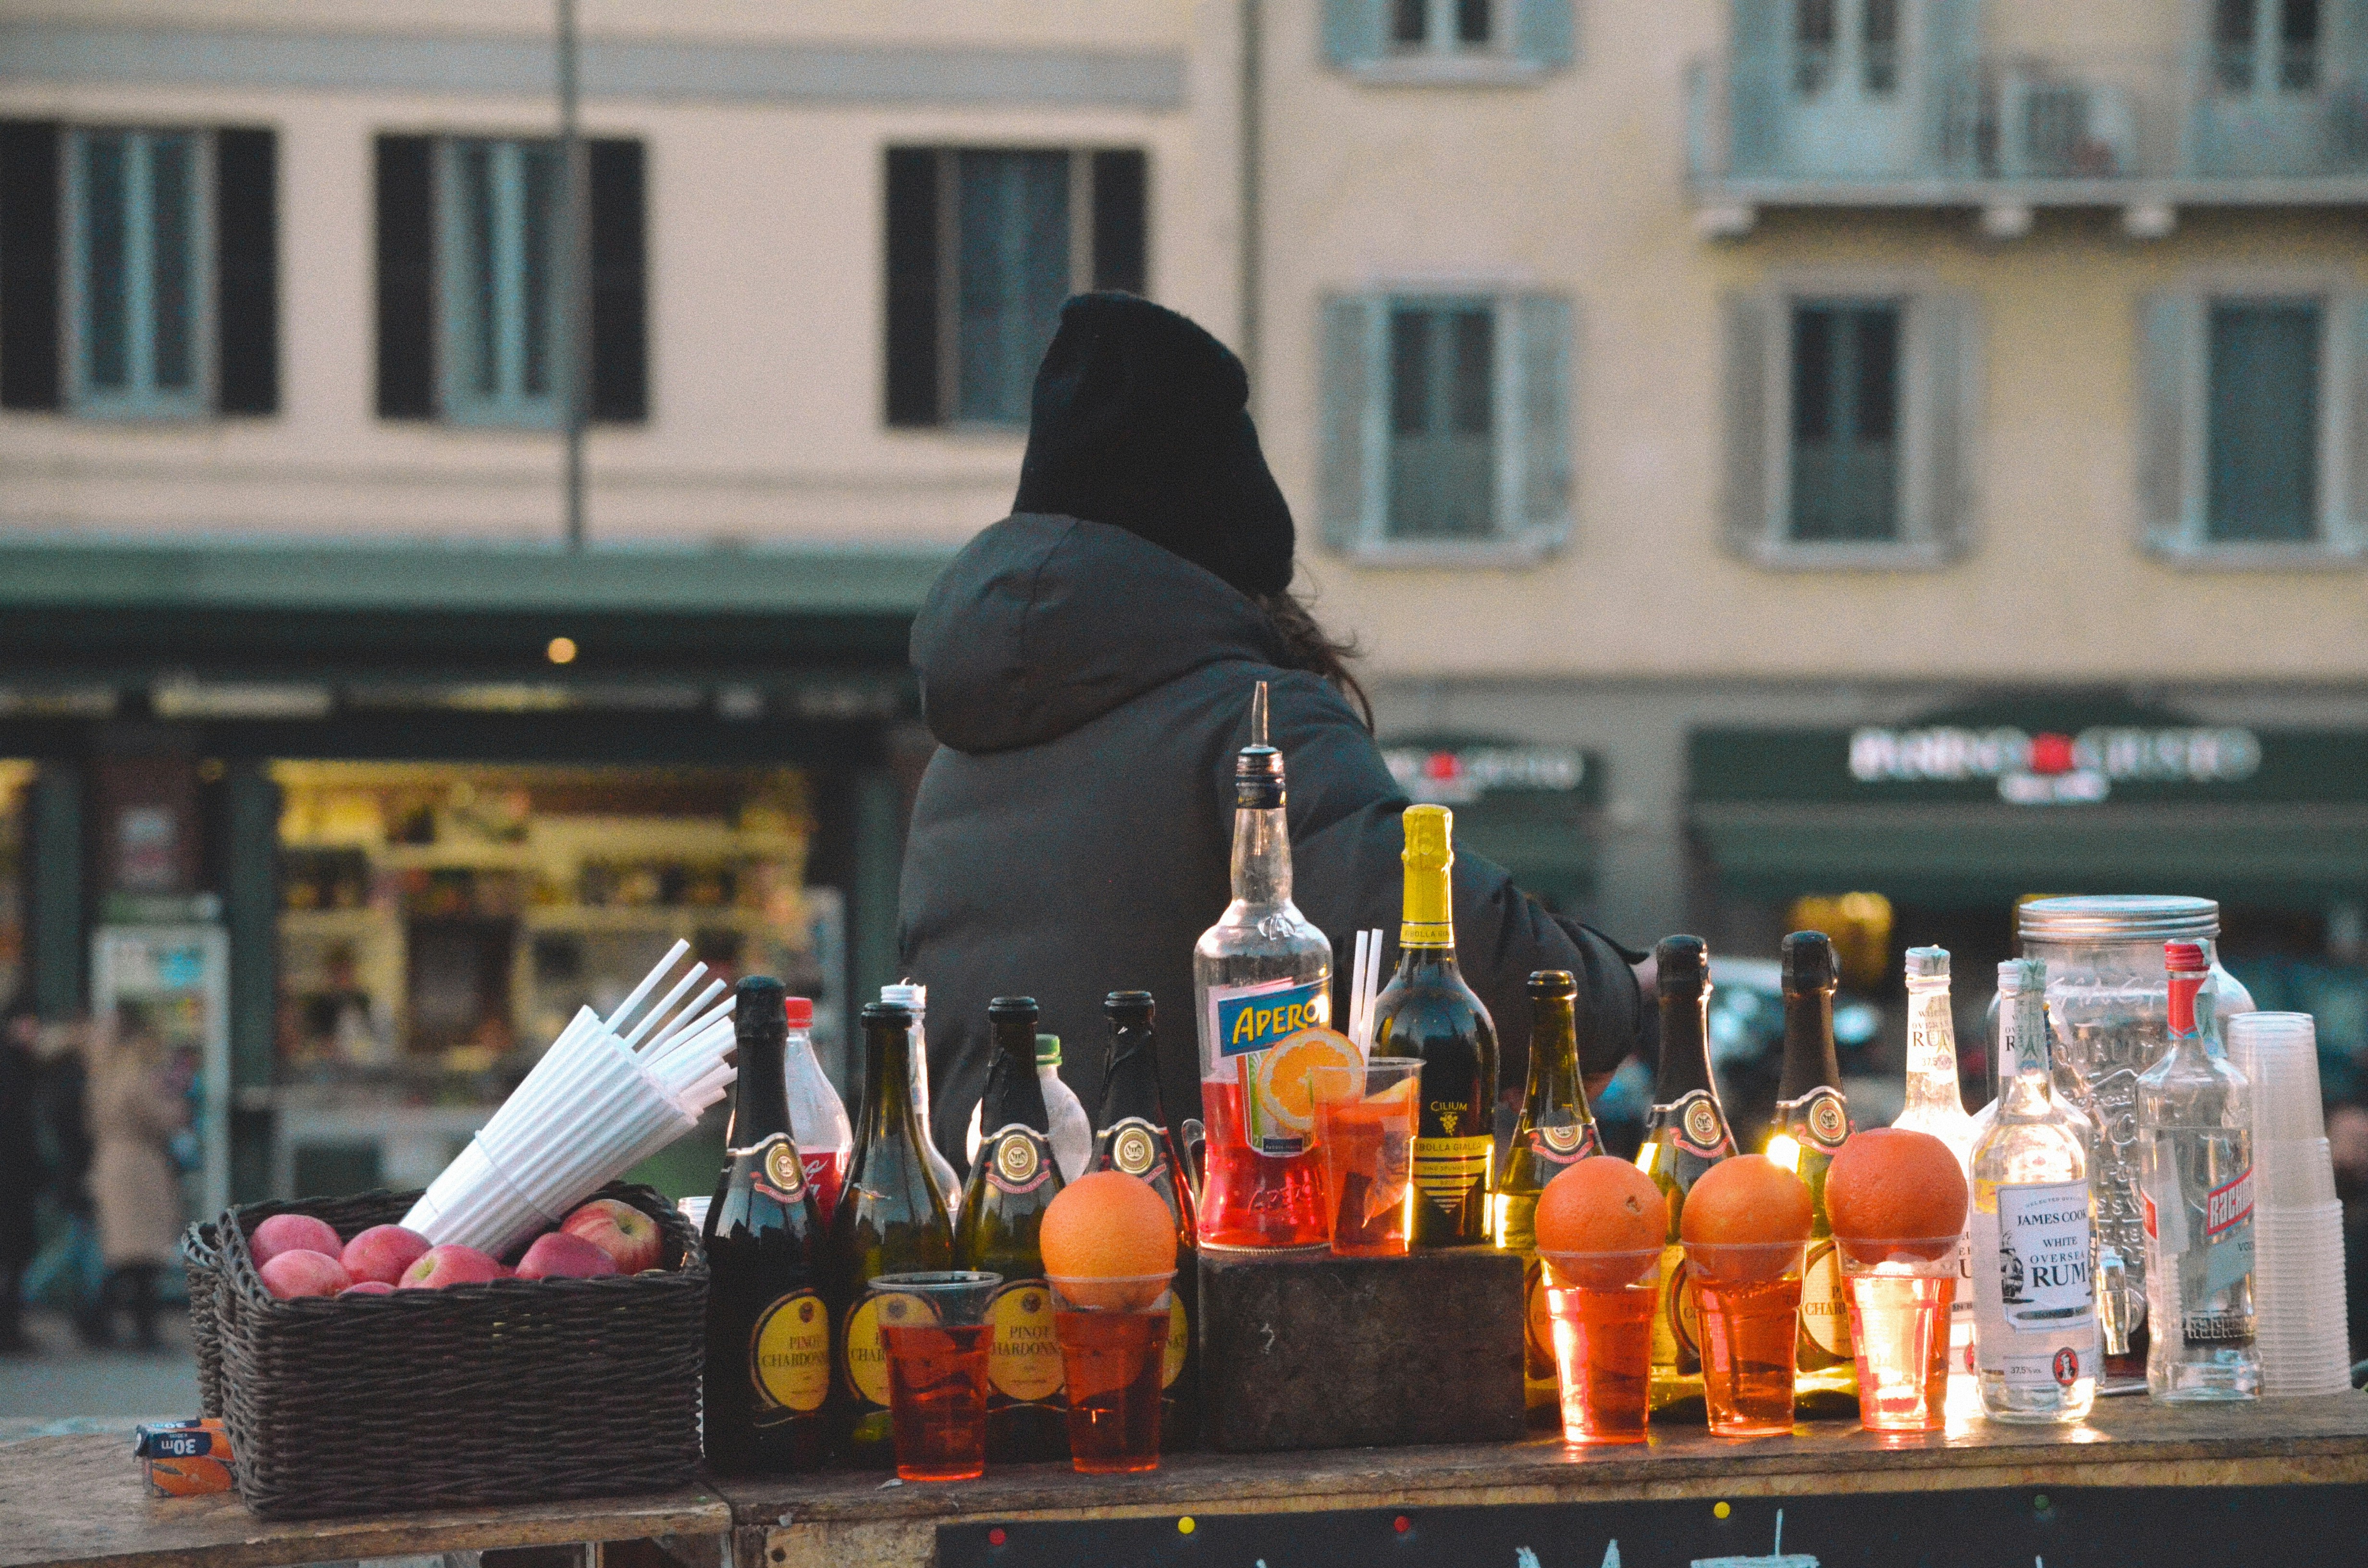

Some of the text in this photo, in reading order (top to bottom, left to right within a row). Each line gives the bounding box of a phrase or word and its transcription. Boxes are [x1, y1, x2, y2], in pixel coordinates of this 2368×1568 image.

[1232, 997, 1324, 1045] APERO
[1430, 1100, 1468, 1112] CILIUM
[1453, 1140, 1481, 1152] GIALLA
[2017, 1213, 2060, 1226] JAMES
[2061, 1208, 2087, 1223] COOK
[2042, 1236, 2078, 1248] WHITE
[2031, 1262, 2087, 1288] RUM
[1010, 1325, 1049, 1338] PINOT
[161, 1438, 196, 1456] 30m
